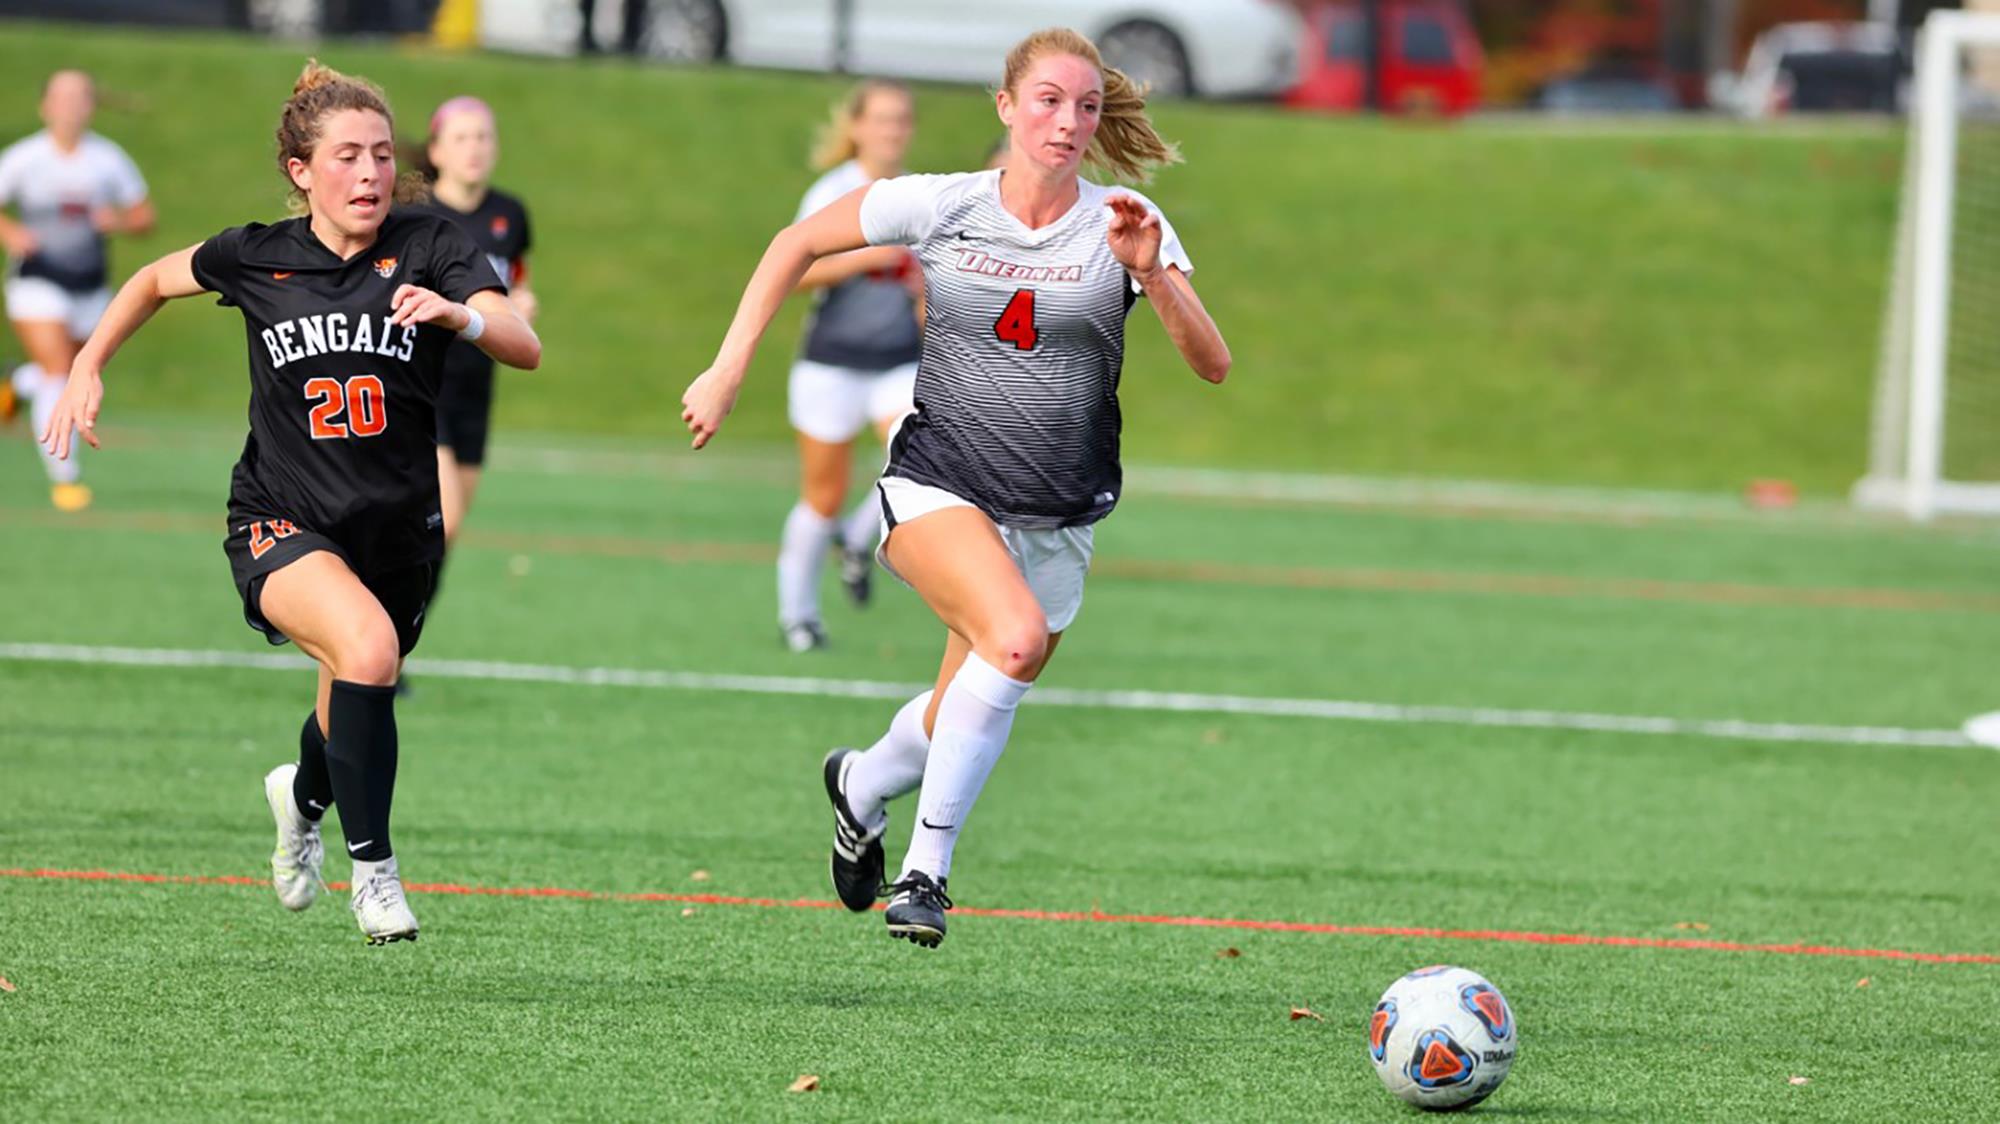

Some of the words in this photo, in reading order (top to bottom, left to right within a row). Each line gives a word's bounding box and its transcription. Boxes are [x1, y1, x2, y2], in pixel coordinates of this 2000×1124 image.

[262, 313, 417, 368] BENGALS
[993, 288, 1039, 350] 4
[304, 375, 387, 439] 20
